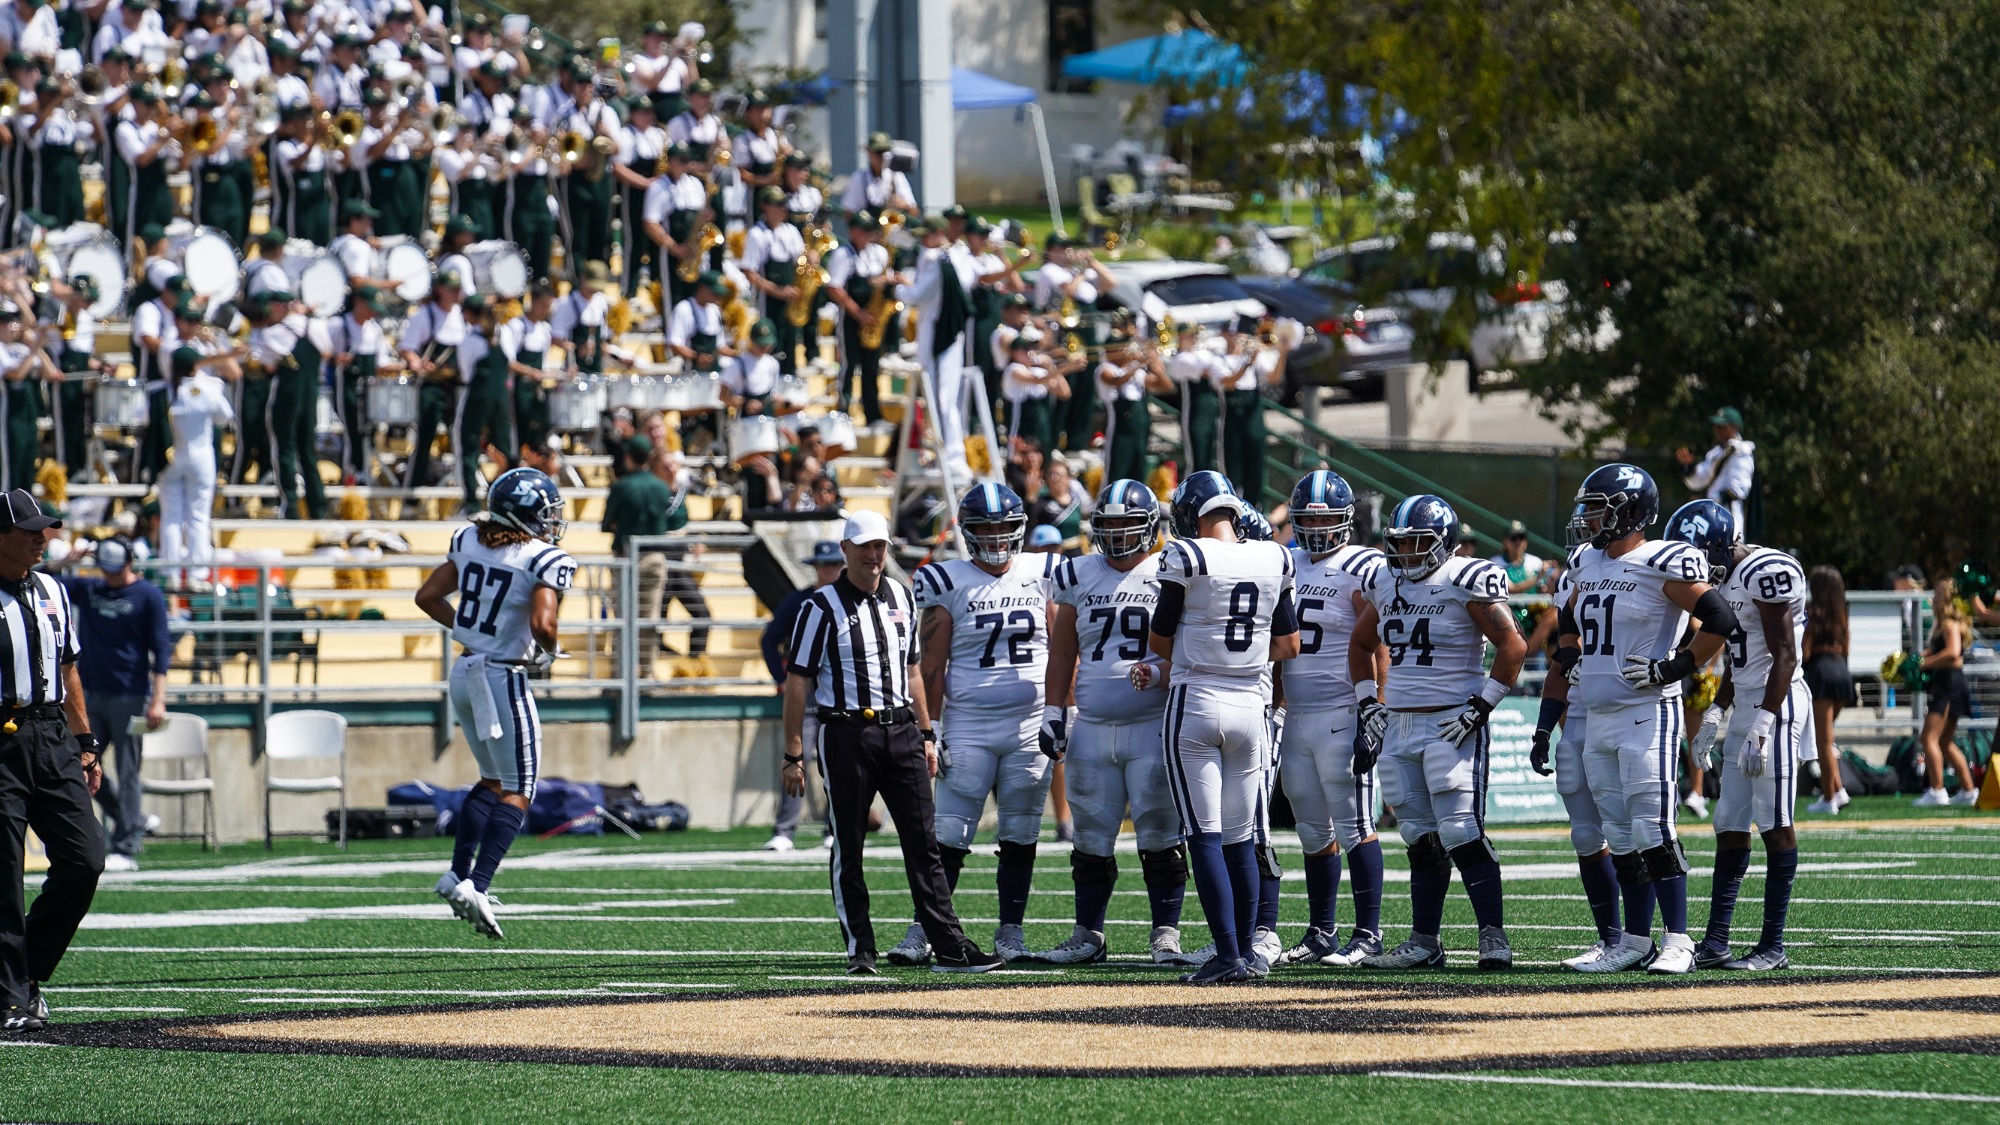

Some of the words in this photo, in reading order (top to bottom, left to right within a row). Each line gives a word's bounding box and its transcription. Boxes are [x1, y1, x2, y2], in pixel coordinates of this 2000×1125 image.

[1681, 556, 1705, 580] 61
[457, 561, 514, 637] 87
[1084, 594, 1113, 607] SAN
[1114, 591, 1159, 605] DIEGO
[1297, 583, 1338, 598] DIEGO
[1485, 573, 1509, 598] 64
[1580, 580, 1598, 593] SAN
[1597, 578, 1638, 592] DIEGO
[1757, 570, 1793, 599] 89
[966, 600, 997, 613] SAN
[1000, 596, 1045, 608] DIEGO
[1224, 581, 1260, 652] 8
[1404, 603, 1446, 615] DIEGO
[975, 609, 1042, 668] 72
[1089, 605, 1150, 662] 79
[1297, 597, 1325, 655] 5
[1580, 593, 1617, 657] 61
[1383, 617, 1436, 667] 64
